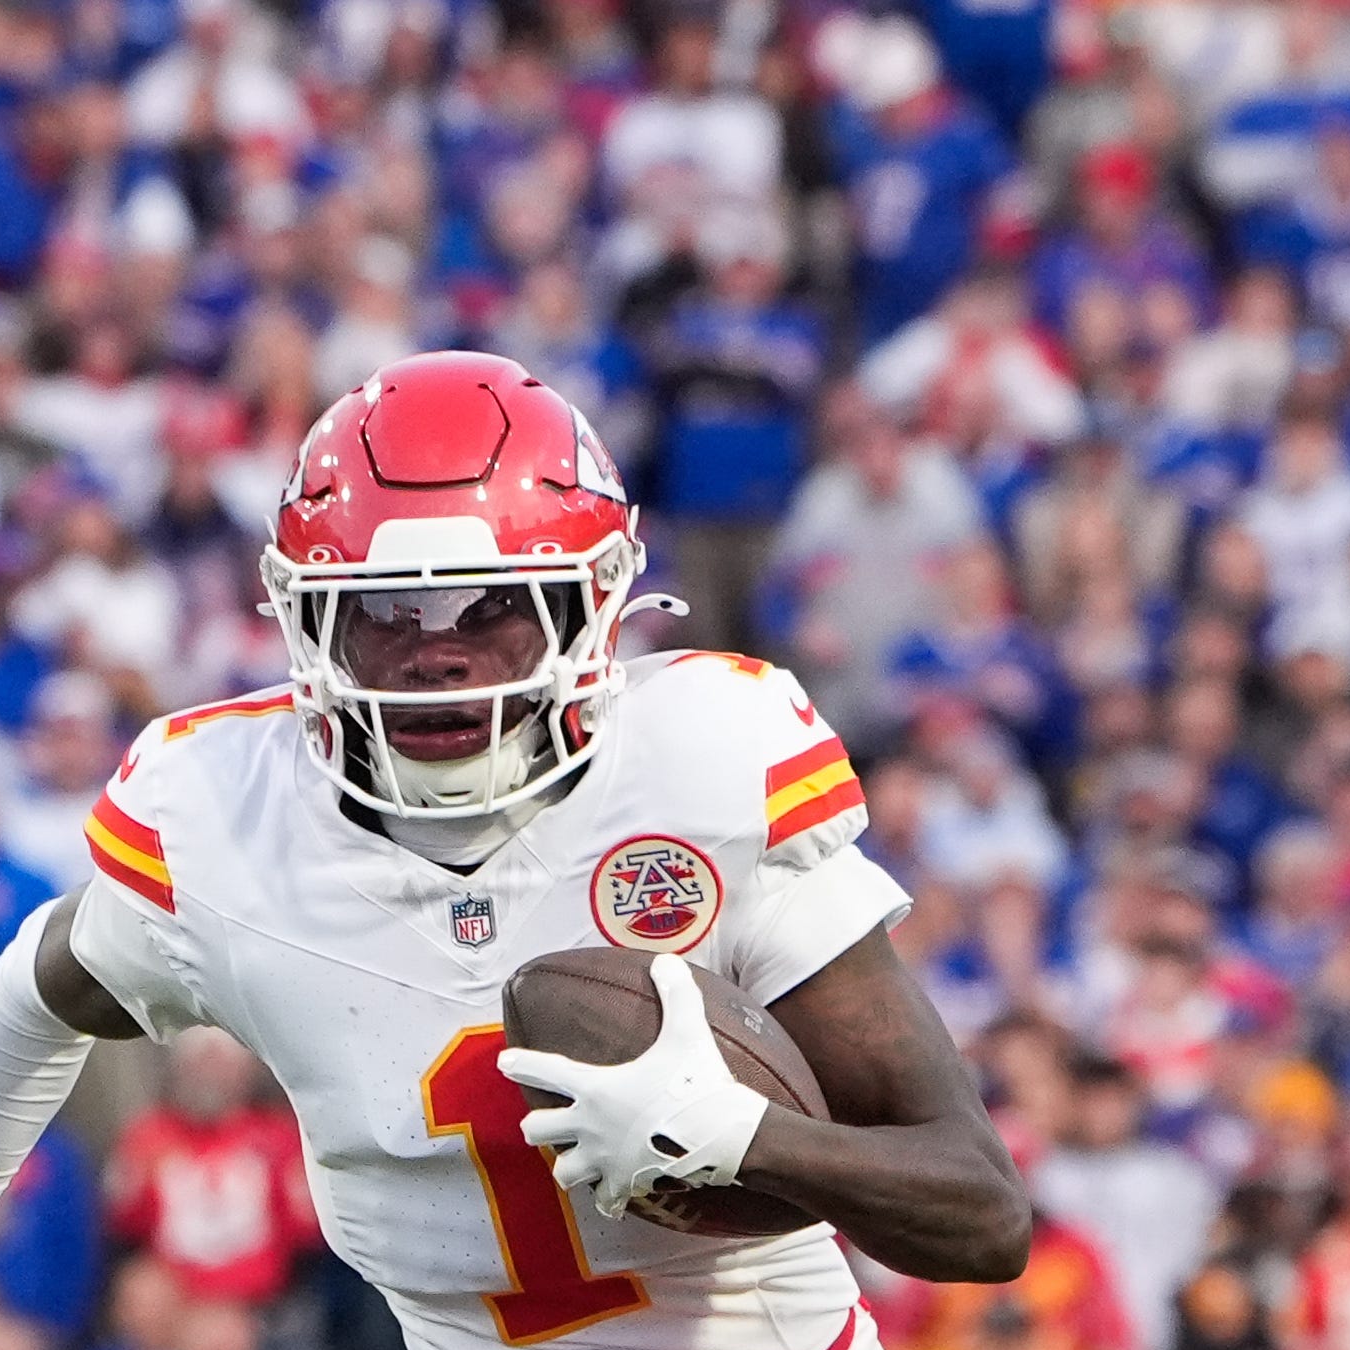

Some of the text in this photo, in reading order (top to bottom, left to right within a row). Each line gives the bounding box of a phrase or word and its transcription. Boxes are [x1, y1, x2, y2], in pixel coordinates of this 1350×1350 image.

[613, 849, 704, 916] A
[458, 918, 489, 941] NFL
[420, 1023, 650, 1346] 1
